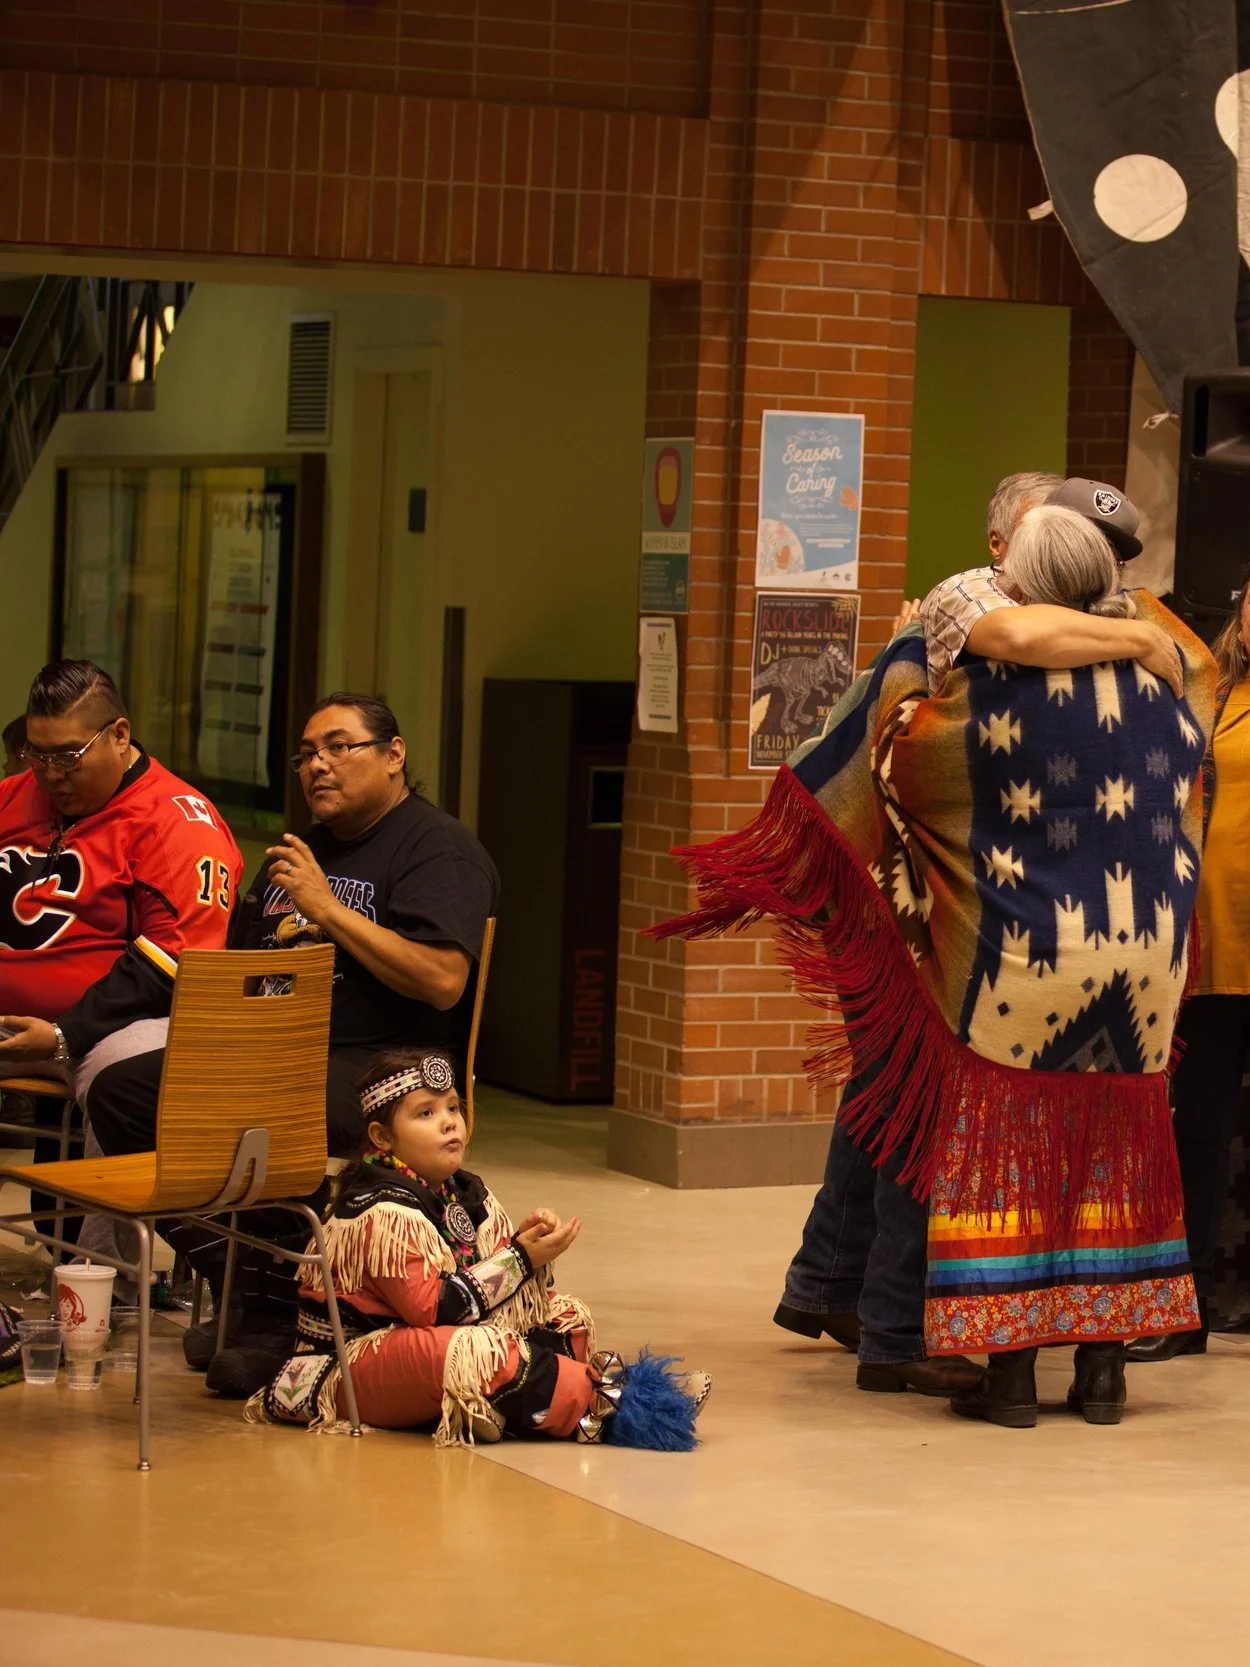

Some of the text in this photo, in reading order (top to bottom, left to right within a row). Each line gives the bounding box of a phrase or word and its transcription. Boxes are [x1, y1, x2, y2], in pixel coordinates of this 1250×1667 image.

[782, 444, 844, 464] Season
[806, 459, 818, 480] of
[786, 473, 837, 498] Caring
[762, 609, 849, 631] ROCKSLIDE
[760, 641, 780, 665] DJ
[756, 734, 800, 751] FRIDAY
[195, 855, 231, 913] 13
[571, 948, 606, 1092] LANDFILL
